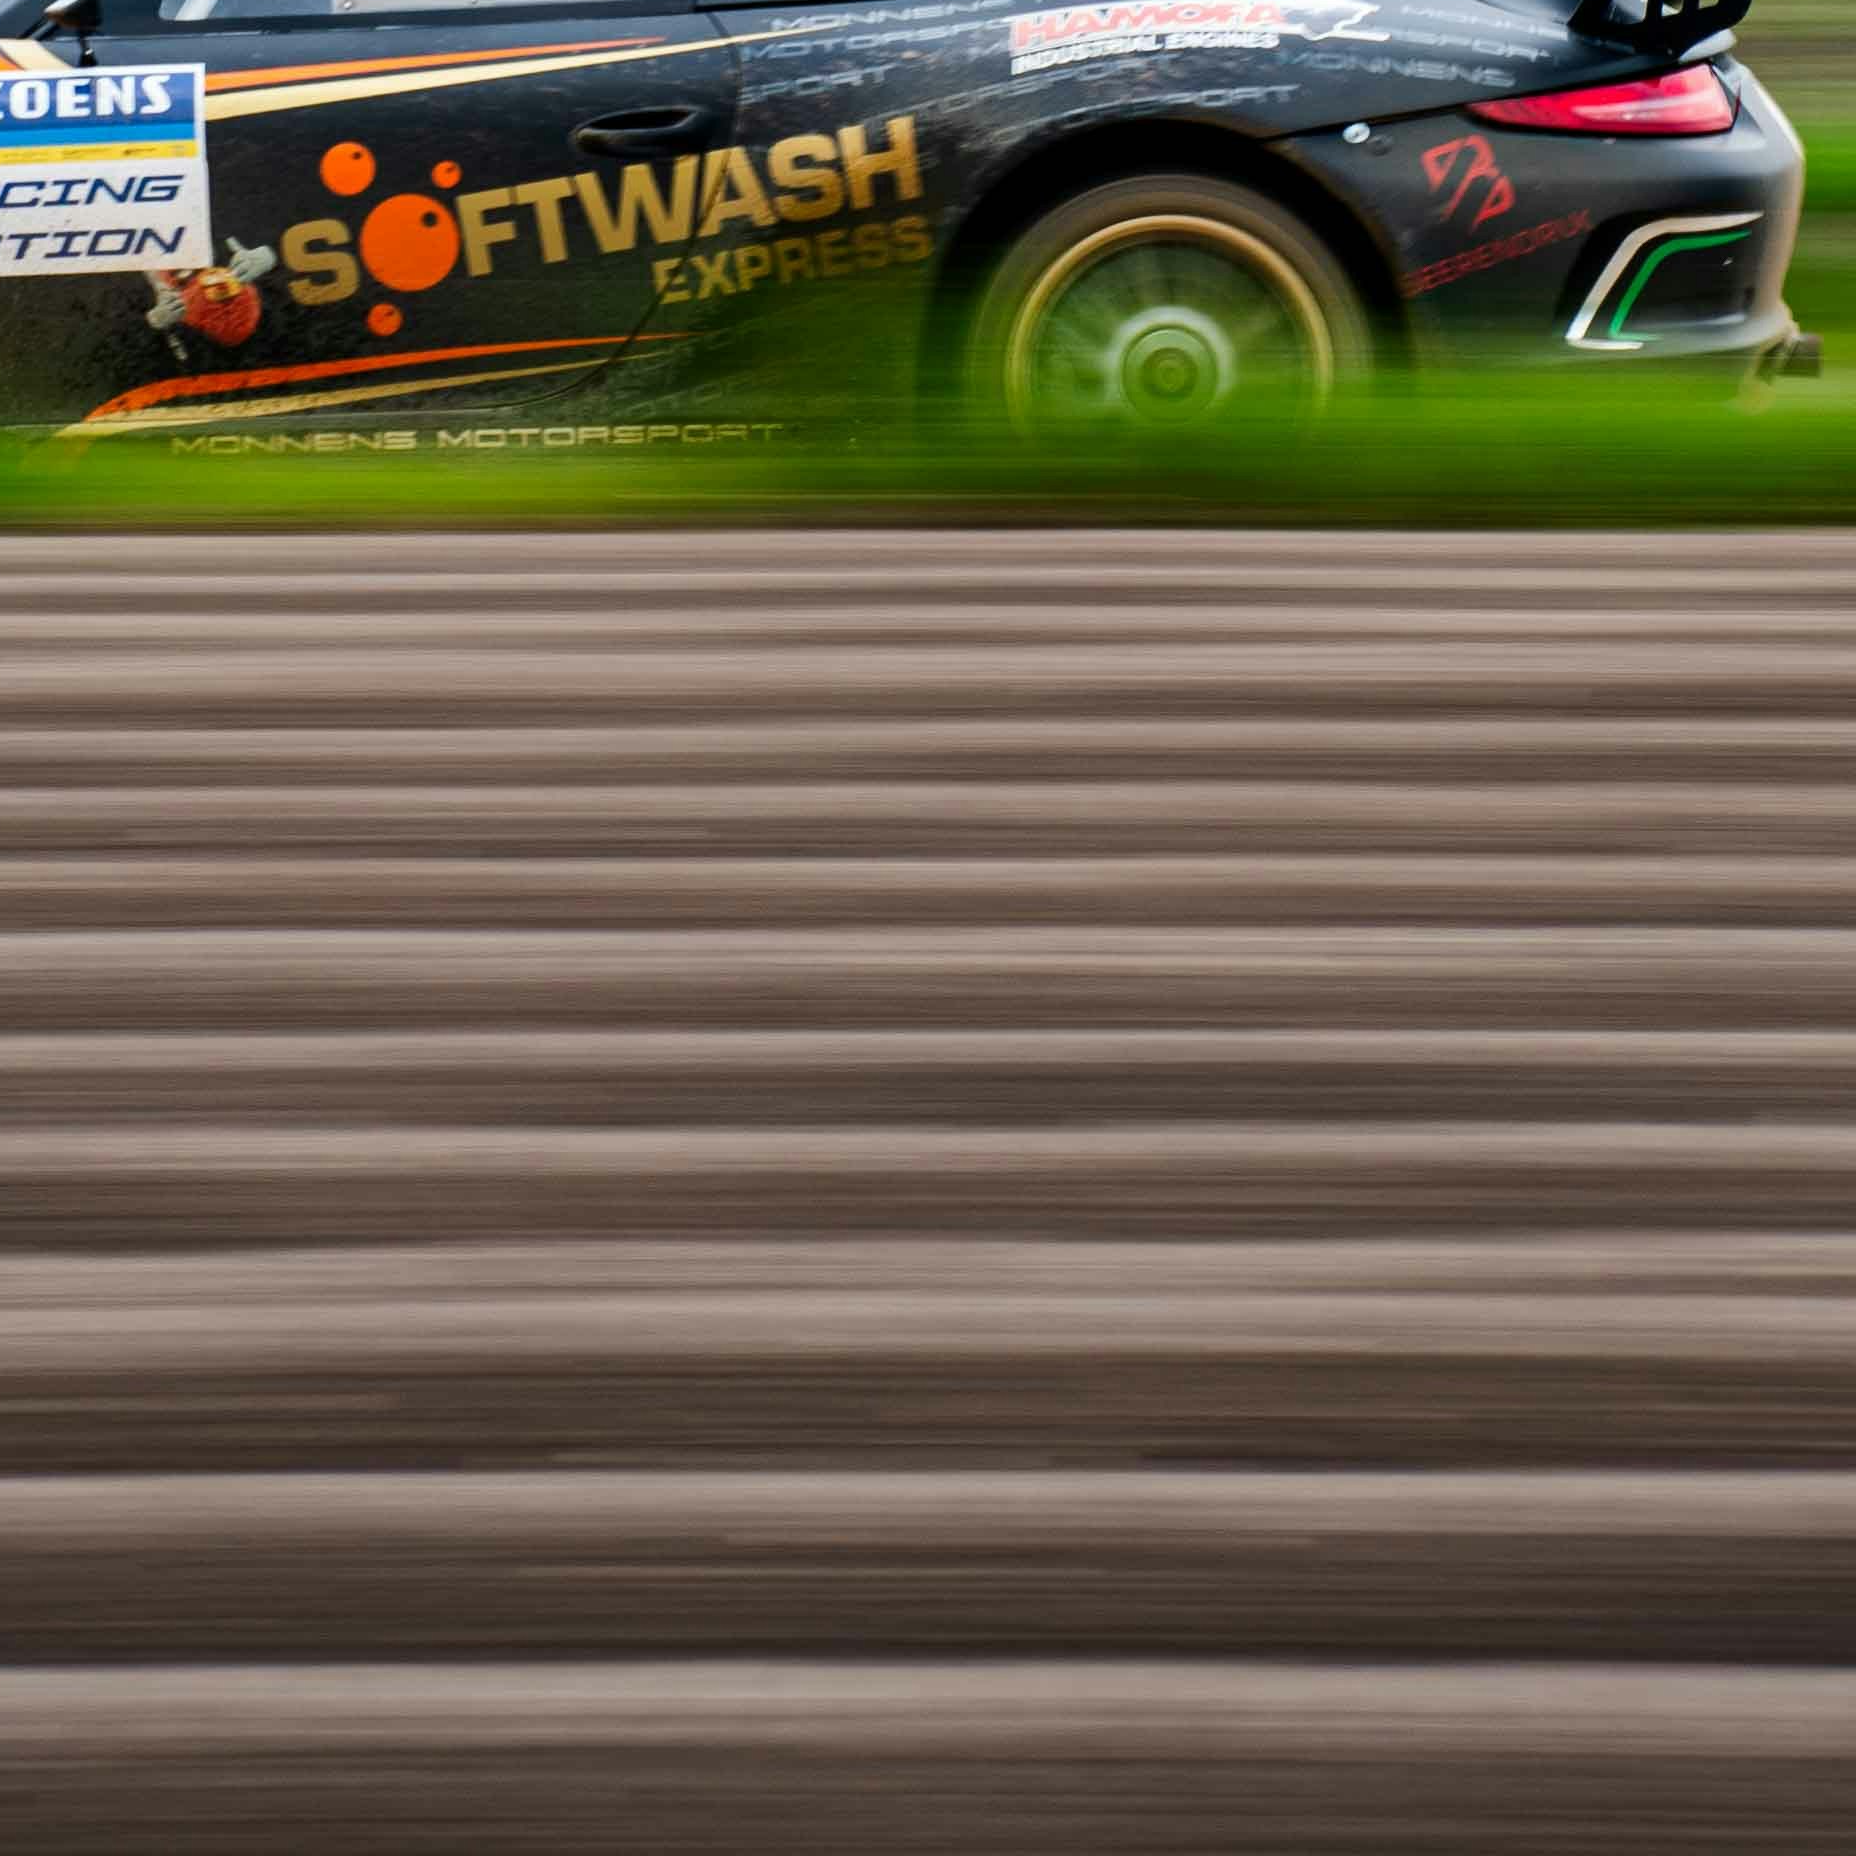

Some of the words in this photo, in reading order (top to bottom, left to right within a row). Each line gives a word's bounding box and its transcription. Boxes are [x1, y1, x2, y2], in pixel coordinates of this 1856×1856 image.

[280, 116, 926, 307] SOFTWASH
[652, 214, 934, 305] EXPRESS
[170, 428, 418, 454] MONNENS
[436, 423, 786, 450] MOTORSPORT
